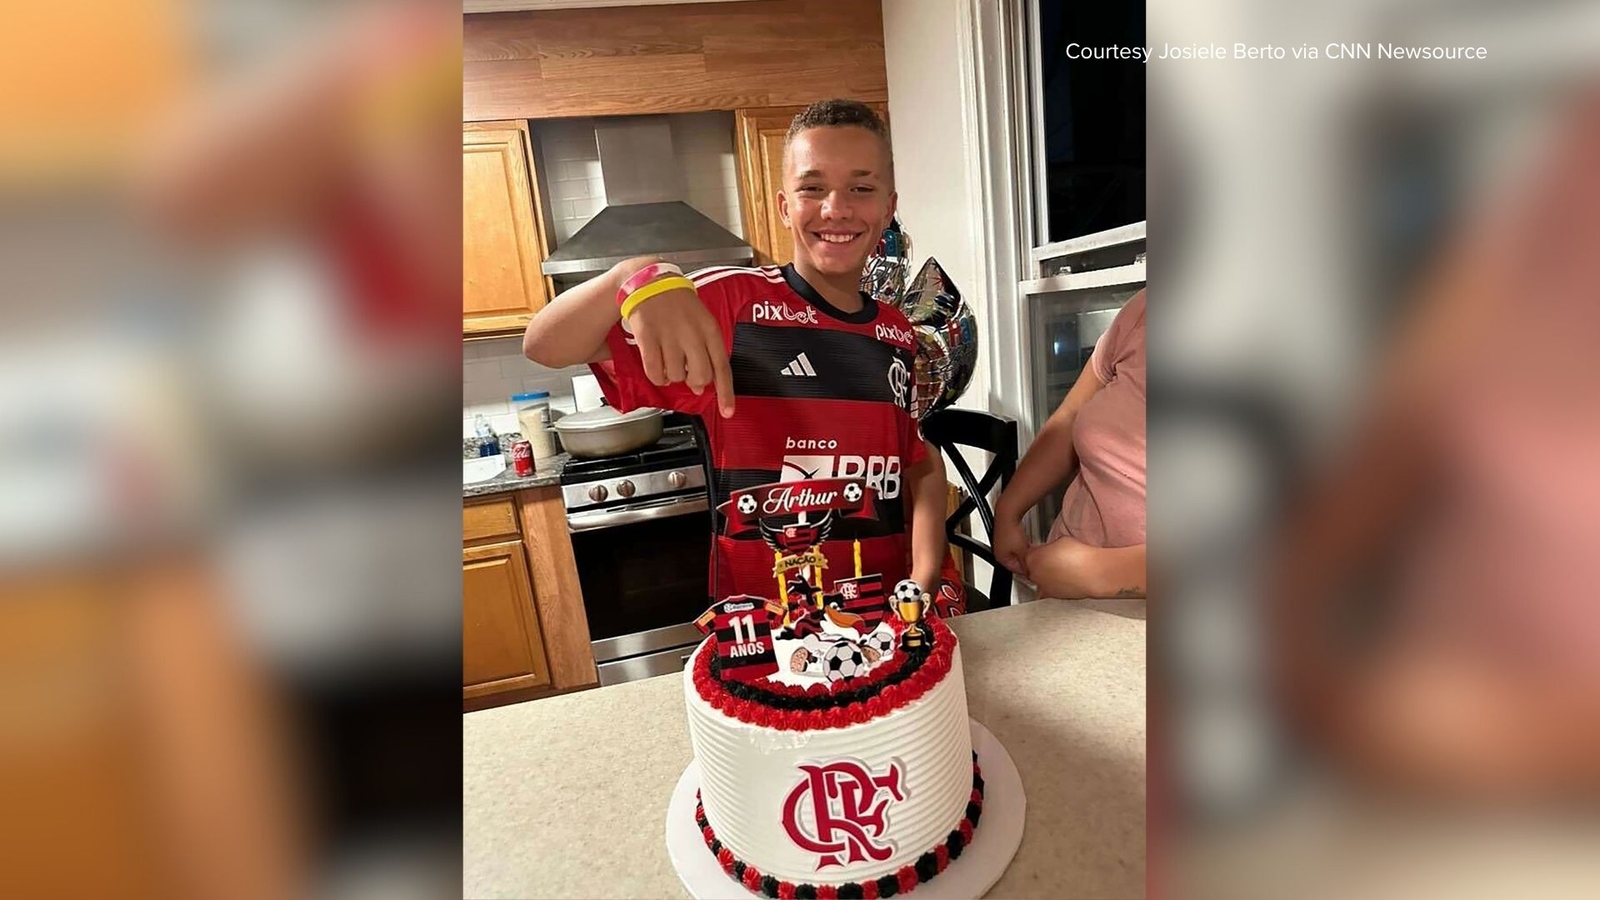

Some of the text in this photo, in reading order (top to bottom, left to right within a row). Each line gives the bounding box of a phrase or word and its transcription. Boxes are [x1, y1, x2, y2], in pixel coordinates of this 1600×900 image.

[752, 300, 819, 325] pixbet
[785, 436, 838, 450] banco
[762, 485, 838, 514] Arthur
[727, 613, 757, 645] 11
[729, 641, 765, 659] ANOS
